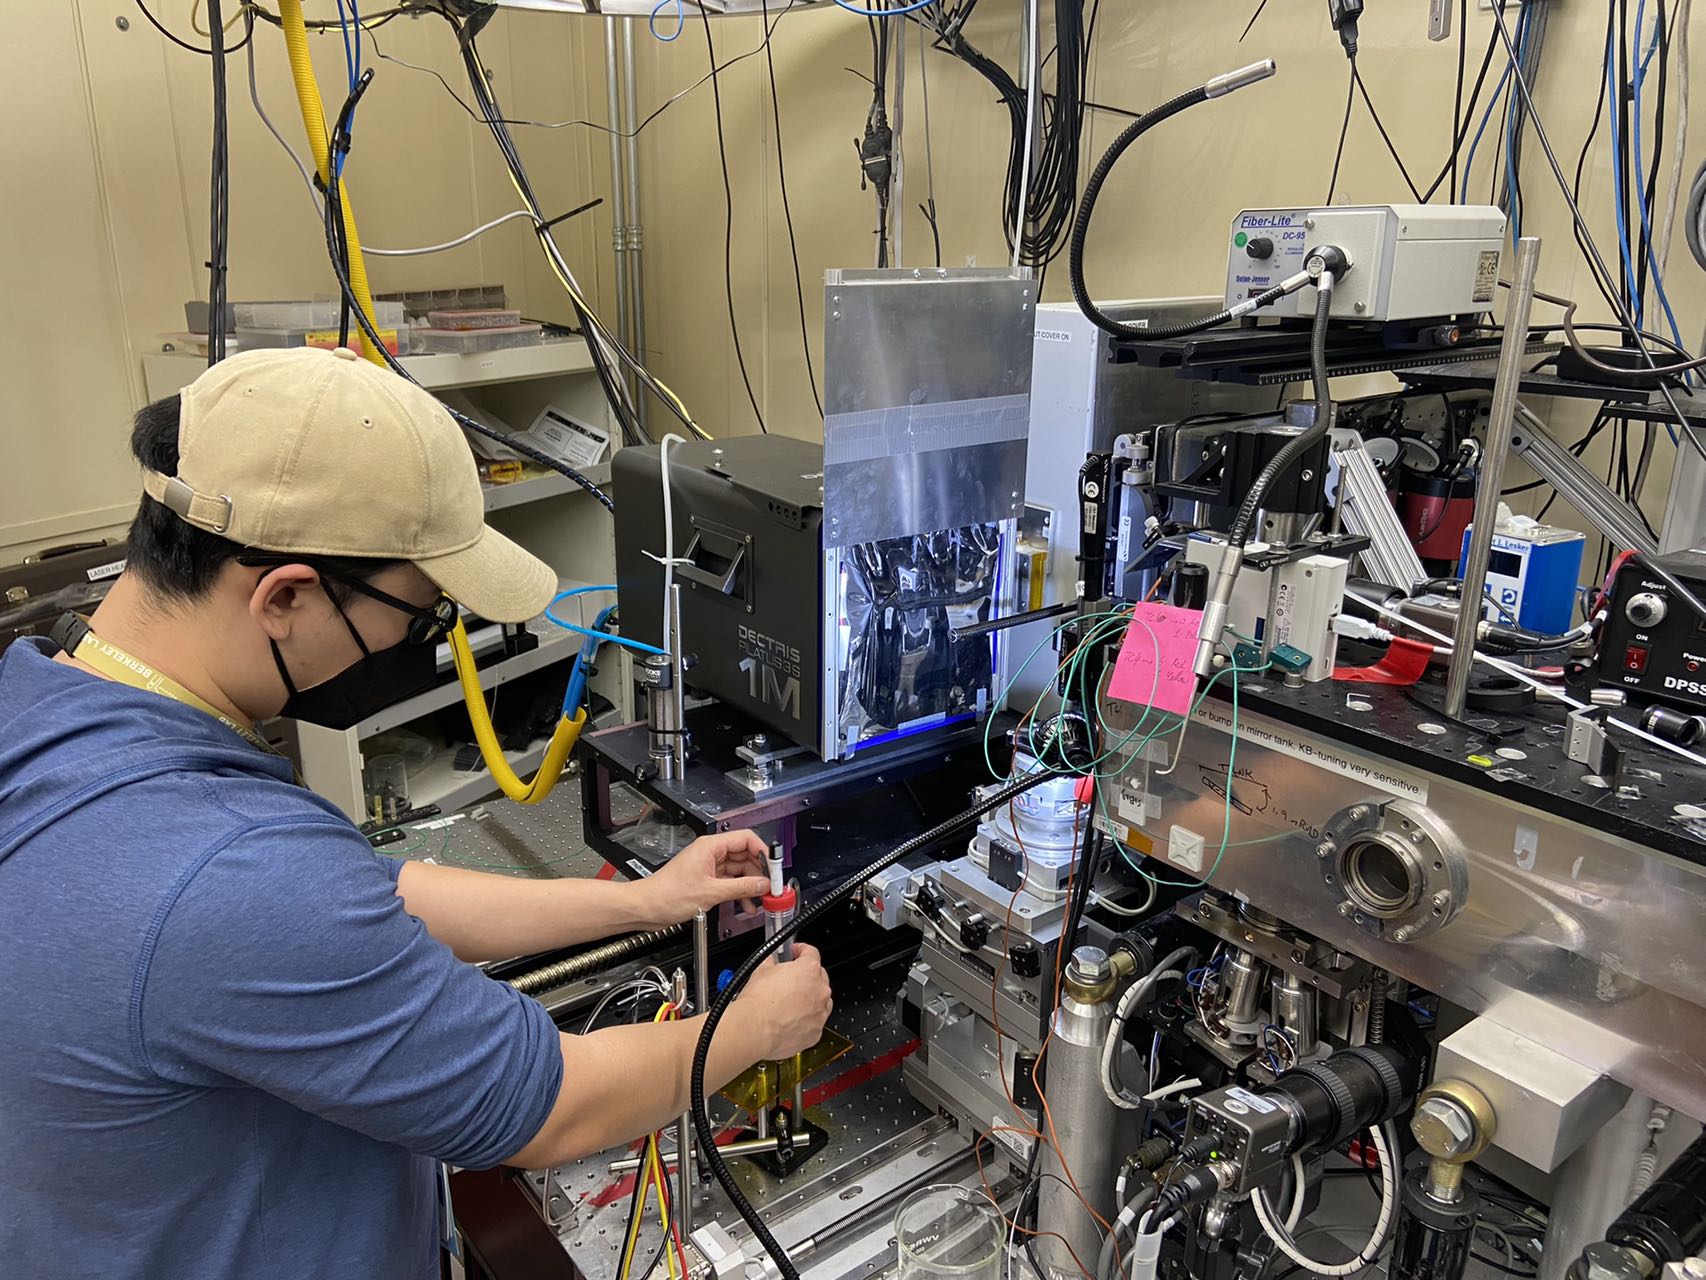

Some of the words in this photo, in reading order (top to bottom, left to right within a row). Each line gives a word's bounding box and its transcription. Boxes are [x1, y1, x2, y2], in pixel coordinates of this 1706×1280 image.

[1241, 215, 1291, 228] Fiber-Lite
[1041, 331, 1060, 340] COVER
[1061, 333, 1070, 341] ON
[1504, 540, 1529, 552] Lesker
[90, 566, 111, 578] LASER
[1641, 580, 1667, 590] Adjust
[1635, 633, 1649, 641] ON
[738, 624, 800, 664] DECTRIS
[99, 643, 153, 679] BERKELEY
[1683, 652, 1706, 663] Powe
[1623, 676, 1640, 684] OFF
[1664, 676, 1706, 696] DPSS
[738, 657, 800, 720] 1M
[1198, 709, 1207, 718] or
[1208, 711, 1232, 727] bump
[1246, 725, 1273, 741] mirror
[1298, 743, 1347, 770] KB-tuning
[1350, 762, 1371, 777] very
[1373, 770, 1422, 796] sensitive.
